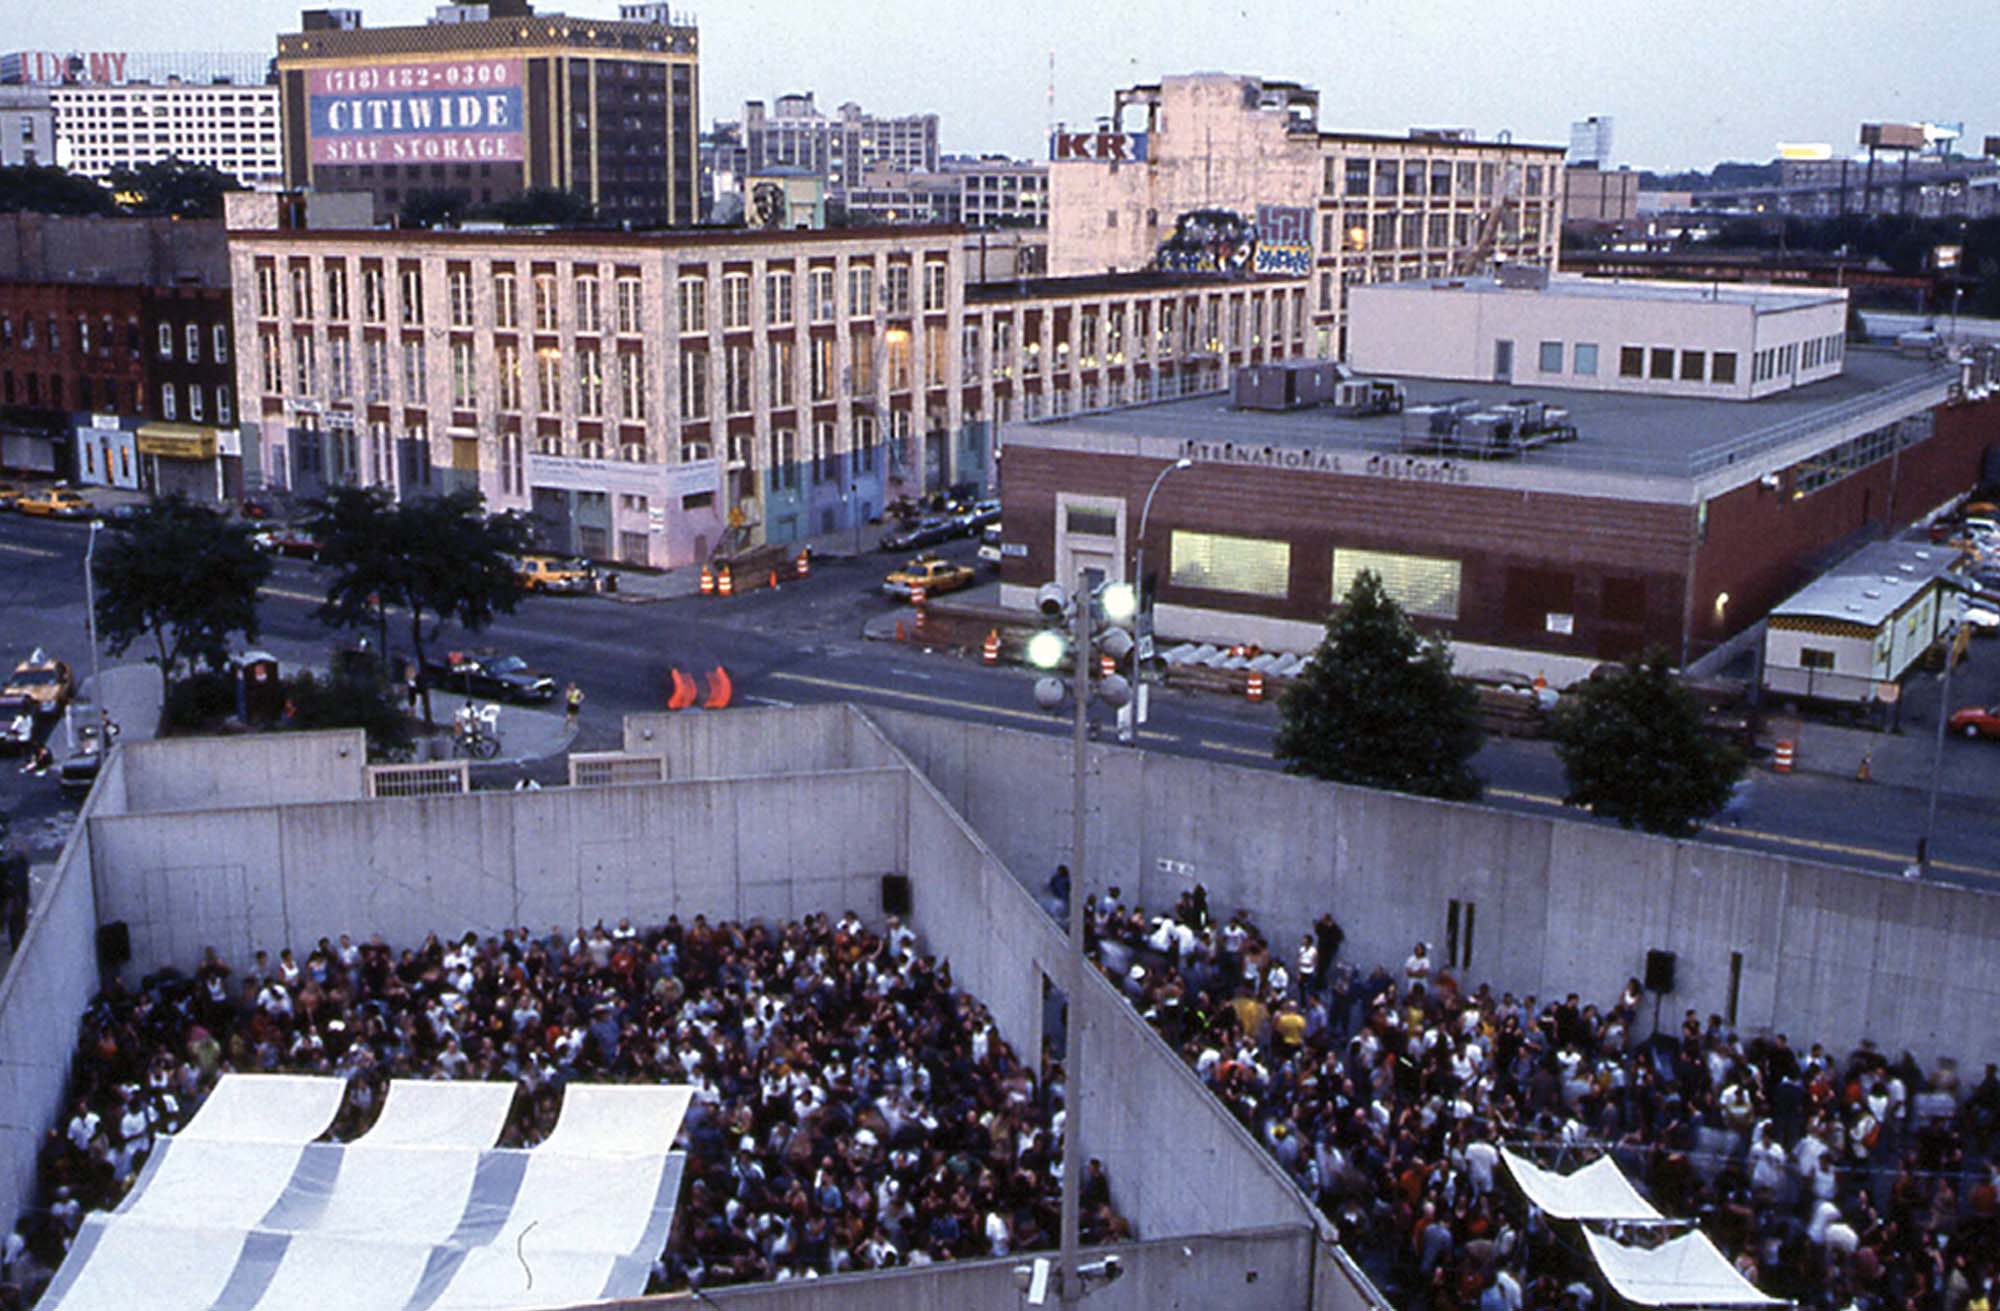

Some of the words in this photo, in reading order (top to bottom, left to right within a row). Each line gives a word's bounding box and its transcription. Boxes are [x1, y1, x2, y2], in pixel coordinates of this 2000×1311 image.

[326, 68, 379, 92] (718)
[387, 63, 507, 87] 482-0300
[328, 95, 509, 130] CITIWIDE
[327, 139, 382, 160] SELF
[393, 137, 509, 158] STORAGE
[1179, 440, 1342, 471] INTERNATIONAL
[1366, 456, 1471, 482] DELIGHTS
